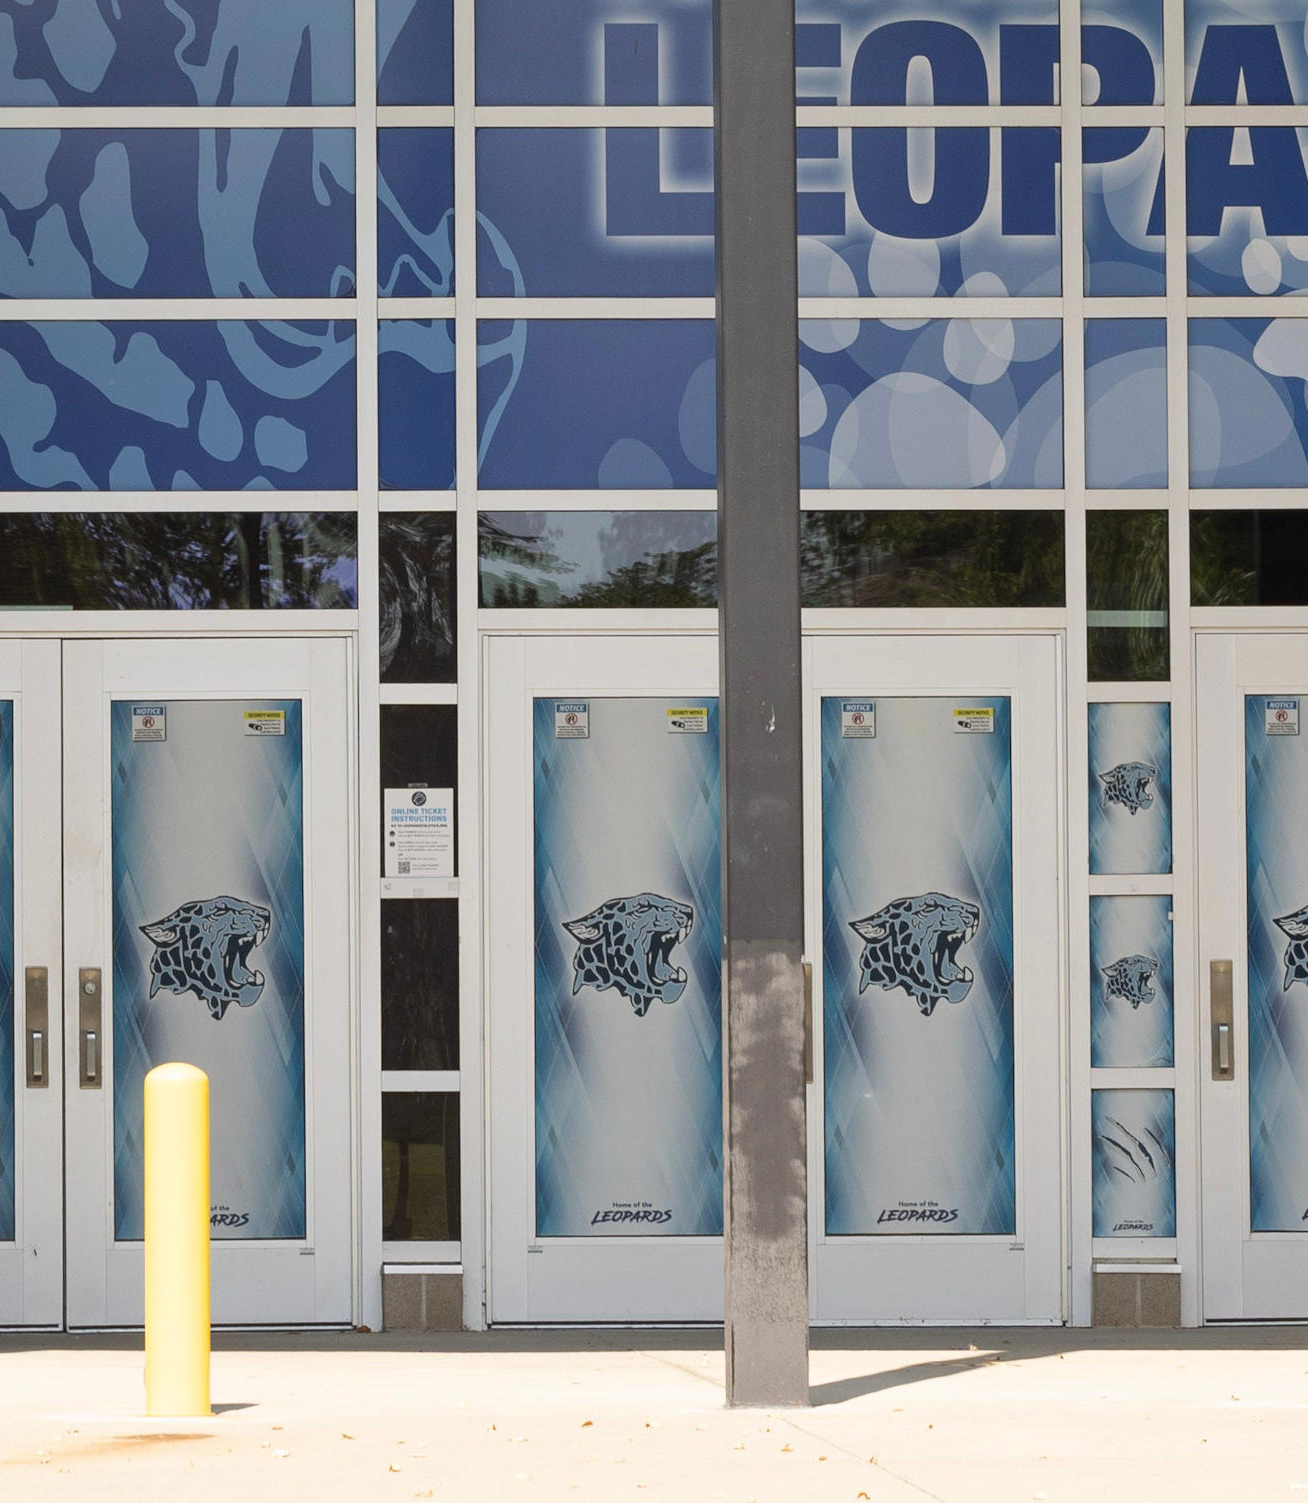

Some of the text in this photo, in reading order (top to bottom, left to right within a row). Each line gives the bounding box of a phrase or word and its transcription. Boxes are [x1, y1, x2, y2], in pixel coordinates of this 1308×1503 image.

[558, 704, 585, 712] NOTICE
[845, 704, 871, 712] NOTICE
[1269, 701, 1294, 709] NOTICE
[135, 707, 162, 715] NOTICE
[591, 1210, 672, 1225] LEOPARDS
[877, 1209, 958, 1224] LEOPARDS
[1112, 1223, 1154, 1232] LEOPARDS
